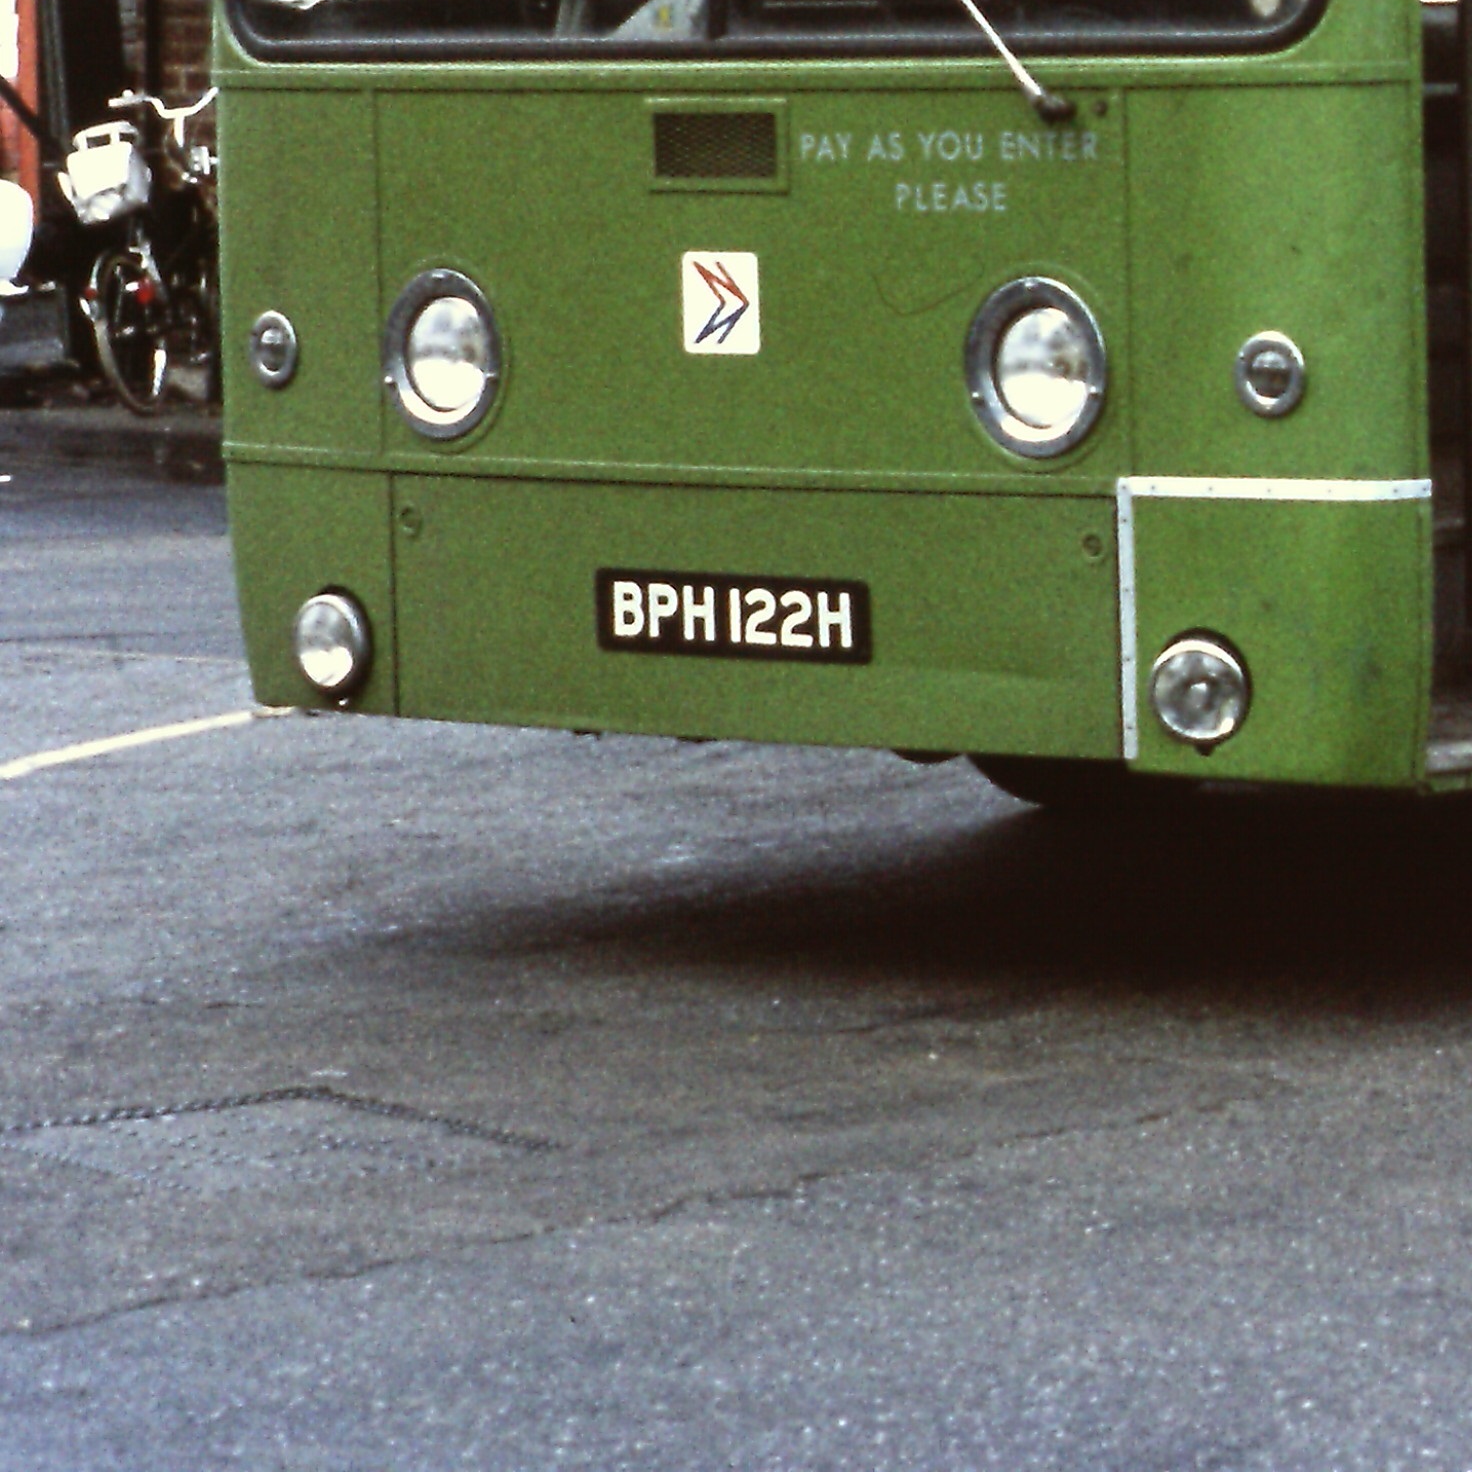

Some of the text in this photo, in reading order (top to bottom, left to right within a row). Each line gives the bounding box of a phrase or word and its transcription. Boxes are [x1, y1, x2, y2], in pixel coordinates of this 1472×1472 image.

[800, 129, 1098, 162] PAY AS YOU ENTER
[895, 182, 1008, 212] PLEASE
[613, 581, 853, 648] BPH 122H
